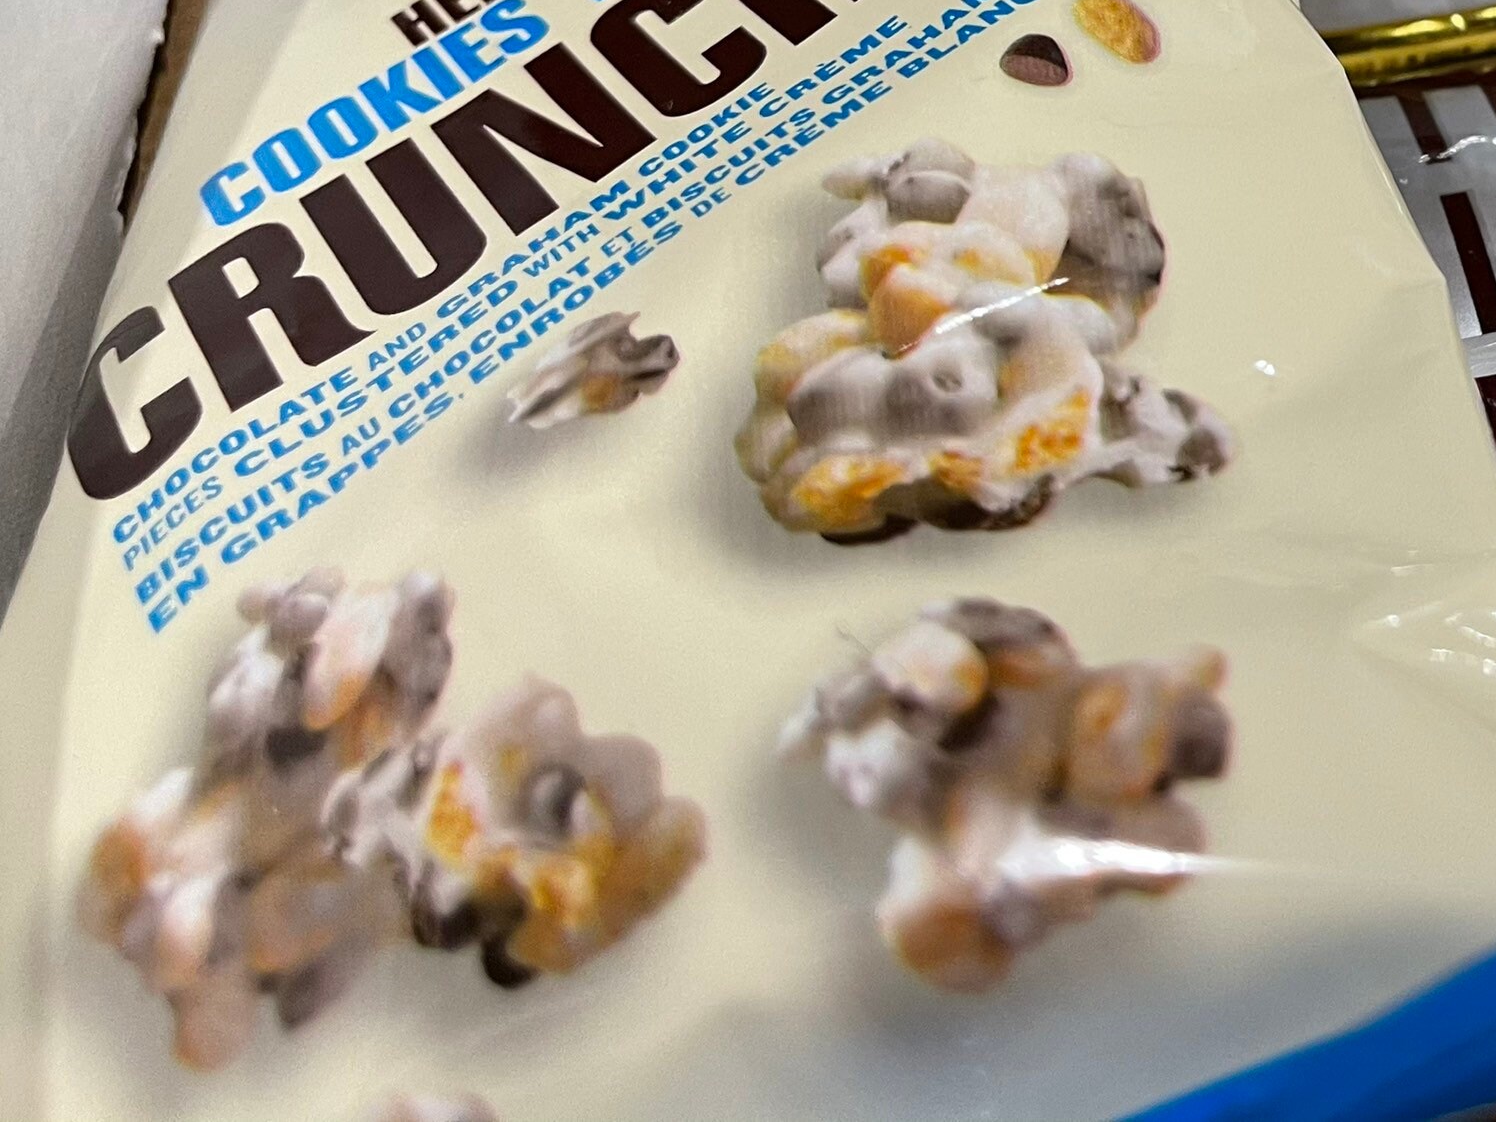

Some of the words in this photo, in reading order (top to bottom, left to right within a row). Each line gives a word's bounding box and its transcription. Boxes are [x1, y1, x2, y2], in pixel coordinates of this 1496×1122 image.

[113, 366, 359, 543] CHOCOLATE
[367, 321, 427, 371] AND
[436, 180, 631, 318] GRAHAM
[638, 82, 776, 177] COOKIE
[123, 475, 225, 571] PIECES
[233, 280, 518, 477] CLUSTERED
[522, 223, 600, 277] WITH
[602, 121, 752, 221] WHITE
[759, 15, 908, 118] CRÈME
[135, 453, 330, 605] BISCUITS
[341, 417, 381, 456] AU
[388, 256, 592, 419] CHOCOLAT
[600, 227, 633, 257] ET
[641, 107, 816, 228] BISCUITS
[148, 564, 210, 635] EN
[468, 221, 684, 385] ENROBÉS
[690, 187, 732, 218] DE
[735, 80, 892, 186] CRÈME
